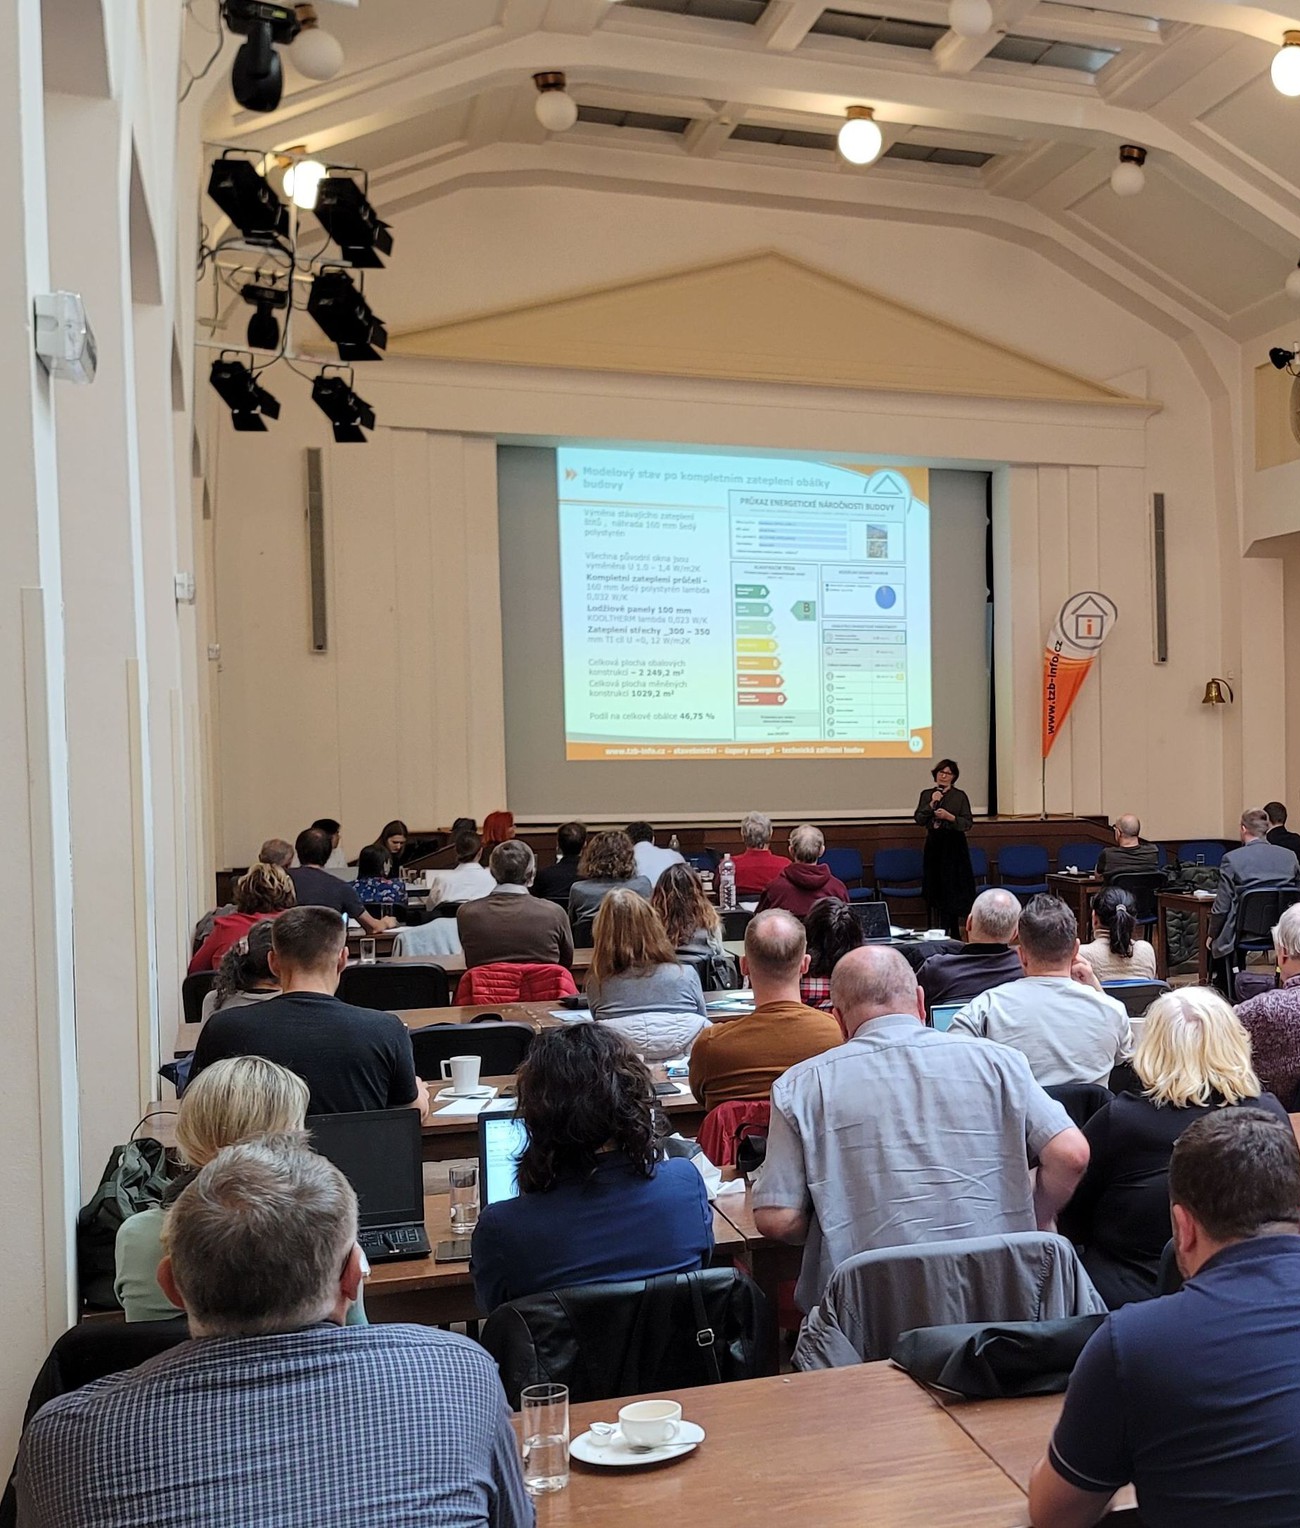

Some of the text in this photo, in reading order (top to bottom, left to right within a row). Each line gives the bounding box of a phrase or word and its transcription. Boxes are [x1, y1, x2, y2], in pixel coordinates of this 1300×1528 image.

[583, 466, 830, 489] Modelový stav po kompletním zateplení obálky
[583, 479, 624, 491] budovy
[866, 503, 895, 511] BUDOVY
[587, 573, 630, 583] Kompletní
[632, 574, 671, 584] zateplení
[627, 605, 655, 614] panely
[658, 606, 674, 614] 100
[803, 601, 810, 613] B
[587, 625, 628, 635] Zateplení
[630, 626, 661, 636] střechy
[694, 628, 711, 636] 350
[638, 669, 645, 677] 2
[1047, 640, 1063, 735] www.tzb-info.cz
[632, 689, 661, 698] 1029,2
[680, 712, 704, 721] 46,75
